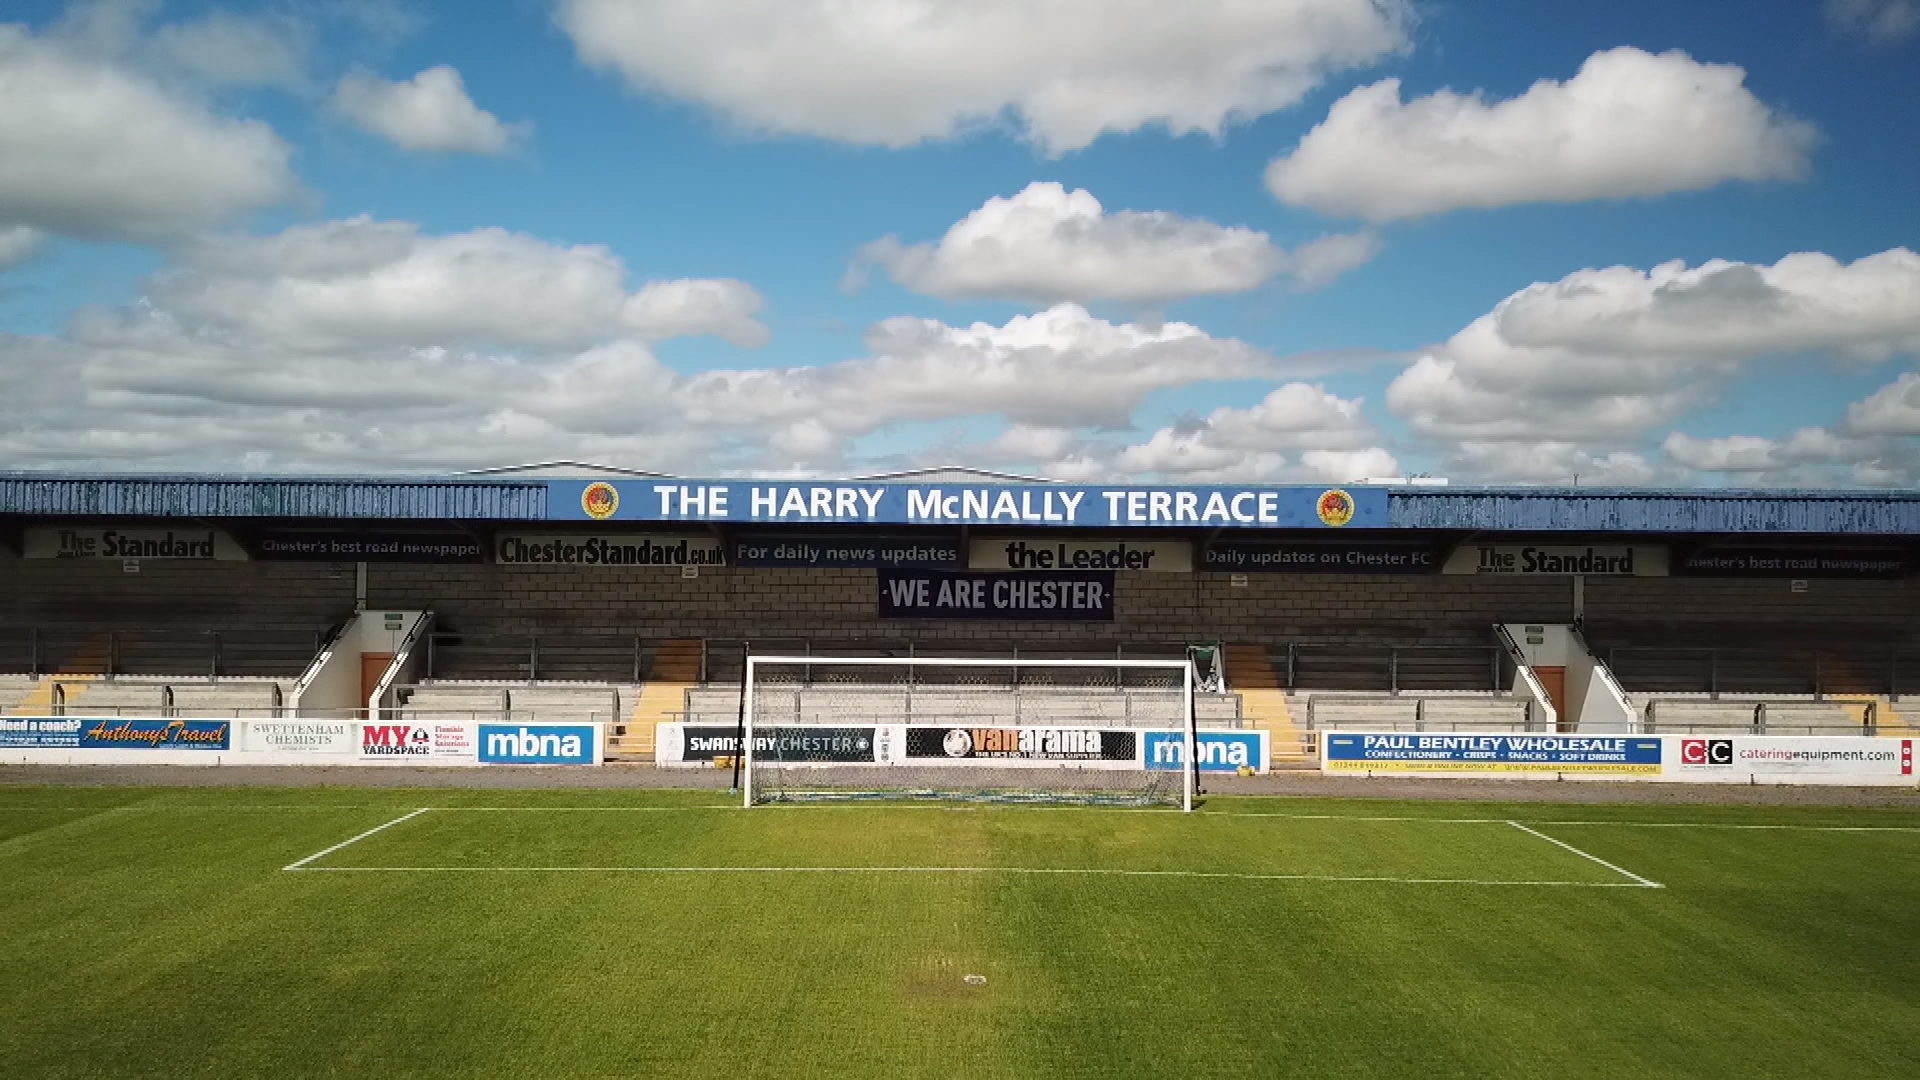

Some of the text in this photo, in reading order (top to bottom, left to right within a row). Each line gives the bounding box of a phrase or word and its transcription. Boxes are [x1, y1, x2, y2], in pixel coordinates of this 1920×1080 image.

[654, 485, 729, 516] THE
[750, 487, 885, 518] HARRY
[906, 489, 1085, 521] McNALLY
[1102, 491, 1278, 523] TERRACE
[58, 529, 215, 557] The Standard
[262, 539, 328, 553] Chester's
[331, 540, 361, 553] best
[370, 541, 399, 553] read
[500, 537, 723, 565] ChesterStandard.co.uk
[736, 543, 957, 566] For daily news updates
[1005, 541, 1155, 569] the Leader
[1205, 549, 1430, 567] Daily updates on Chester FC
[1476, 547, 1634, 573] The Standard
[1749, 555, 1781, 569] best
[1785, 557, 1817, 569] read
[888, 579, 1103, 609] WE ARE CHESTER
[252, 723, 344, 735] SWETTENHAM
[362, 725, 410, 746] MY
[265, 734, 332, 745] CHEMISTS
[487, 727, 581, 757] mbna
[780, 737, 851, 751] CHESTER
[971, 728, 1103, 753] vanarama
[1364, 735, 1626, 752] PAUL BENTLEY WHOLESALE
[362, 745, 430, 755] YARDSPACE
[1364, 750, 1626, 761] CONFECTIONERY CRISPS SNACKS SOFT DRINKS
[1739, 747, 1896, 761] cateringequipment.com
